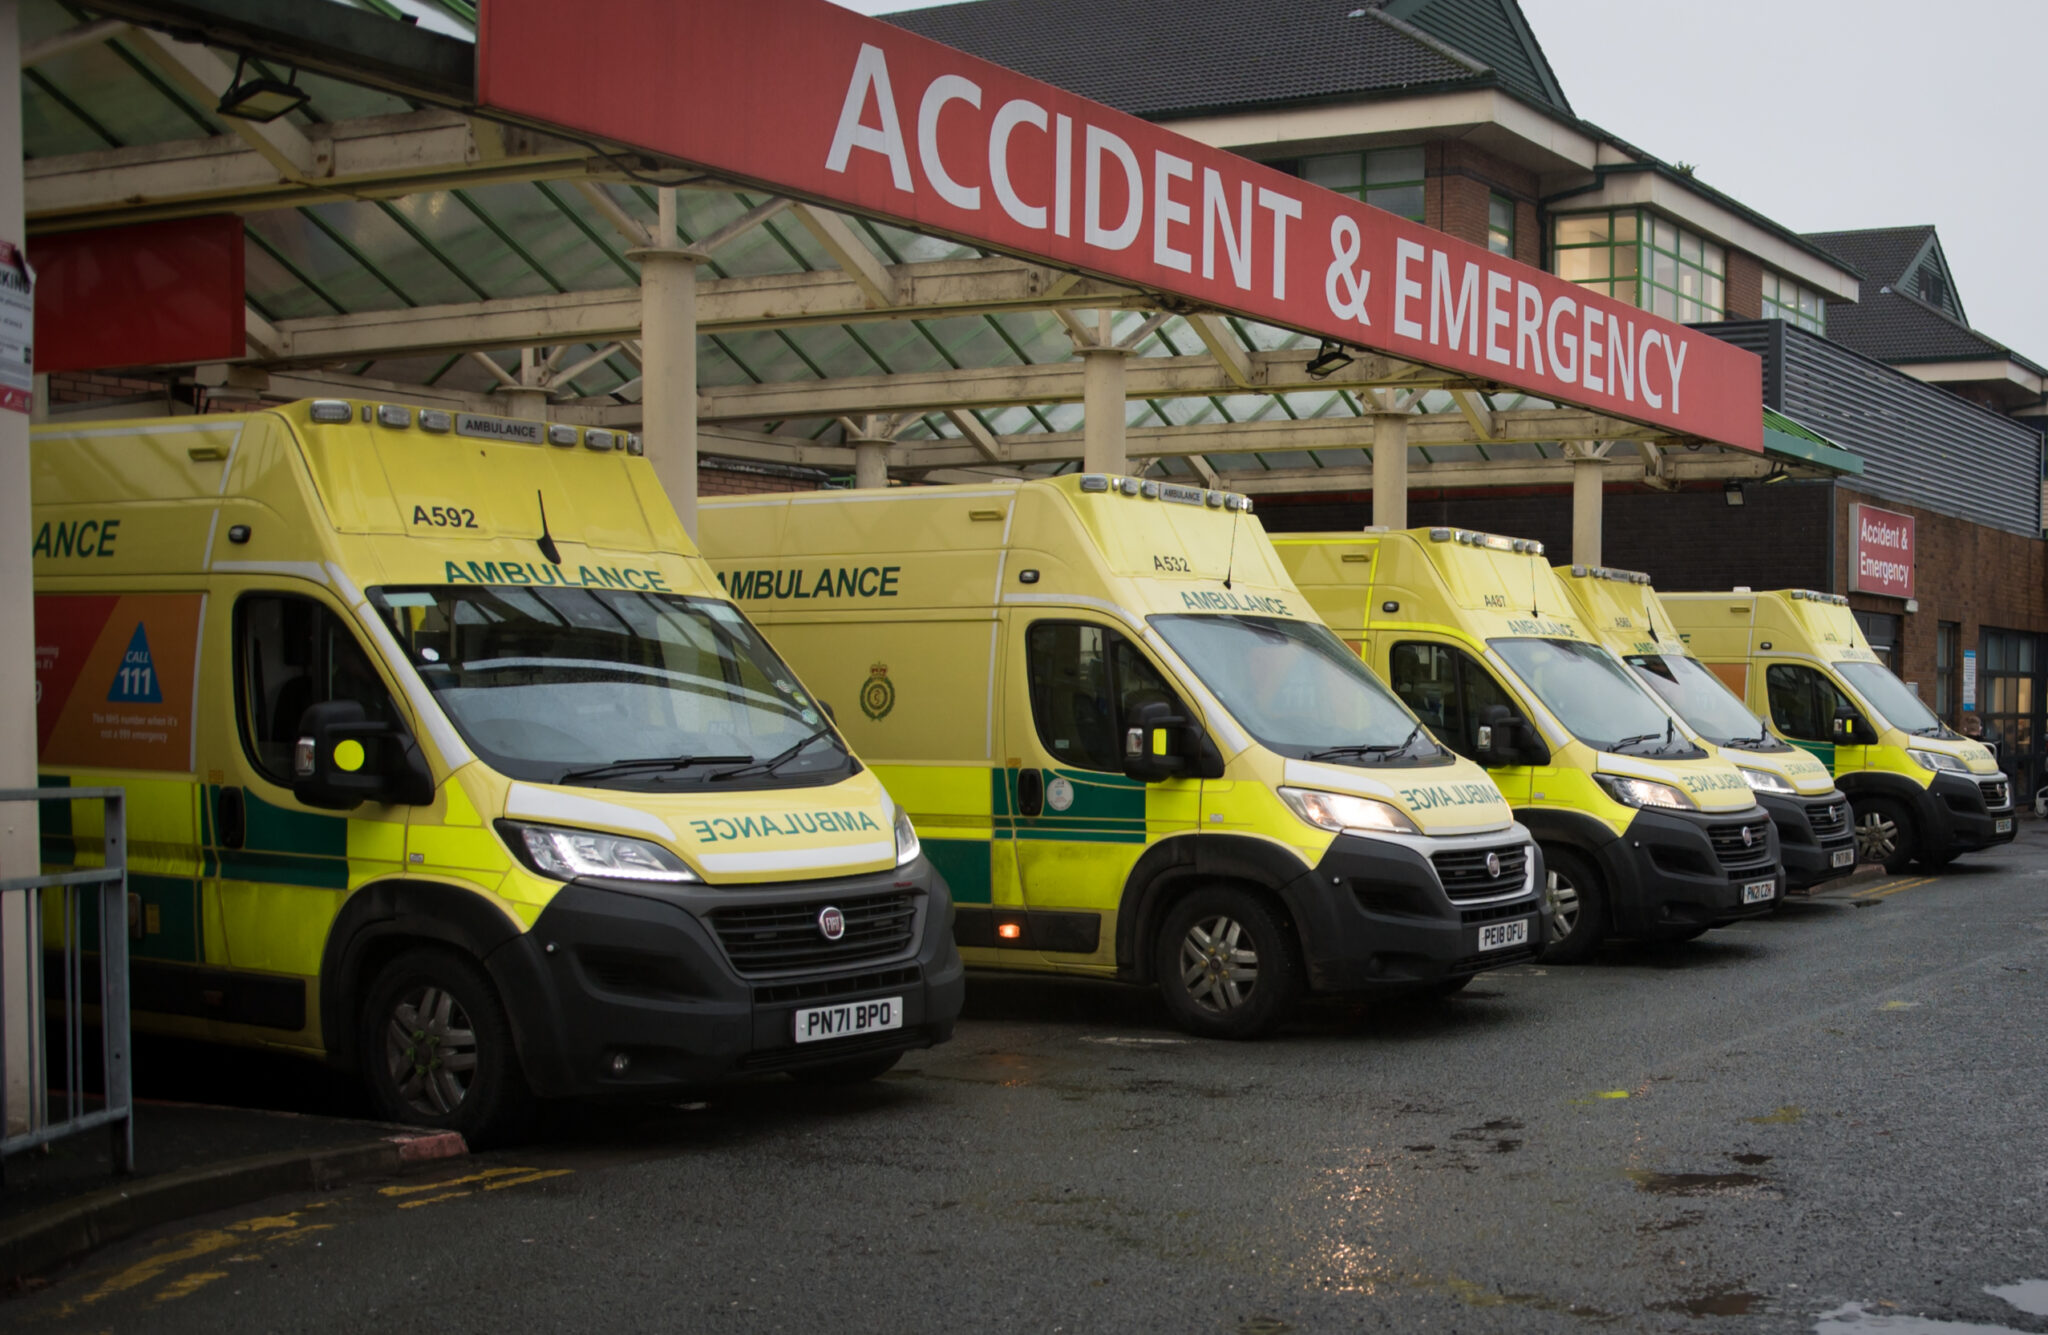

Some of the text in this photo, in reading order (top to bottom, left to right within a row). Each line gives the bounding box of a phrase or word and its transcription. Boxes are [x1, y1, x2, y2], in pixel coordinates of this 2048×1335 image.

[825, 42, 1688, 415] ACCIDENT & EMERGENCY
[0, 270, 30, 294] KING
[465, 419, 536, 438] AMBULANCE
[1164, 488, 1201, 501] AMBULANCE
[412, 505, 478, 528] A592
[33, 519, 120, 558] ANCE
[1861, 517, 1908, 550] Accident &
[1153, 555, 1191, 572] A532
[1861, 551, 1909, 589] Emergency
[444, 560, 673, 592] AMBULANCE
[1181, 591, 1294, 617] AMBULANCE
[1506, 620, 1579, 638] AMBULANCE
[126, 650, 149, 663] CALL
[120, 667, 151, 695] 111
[825, 916, 840, 931] FIAT
[1485, 925, 1504, 947] PE18
[808, 1002, 890, 1036] PN71 BPO
